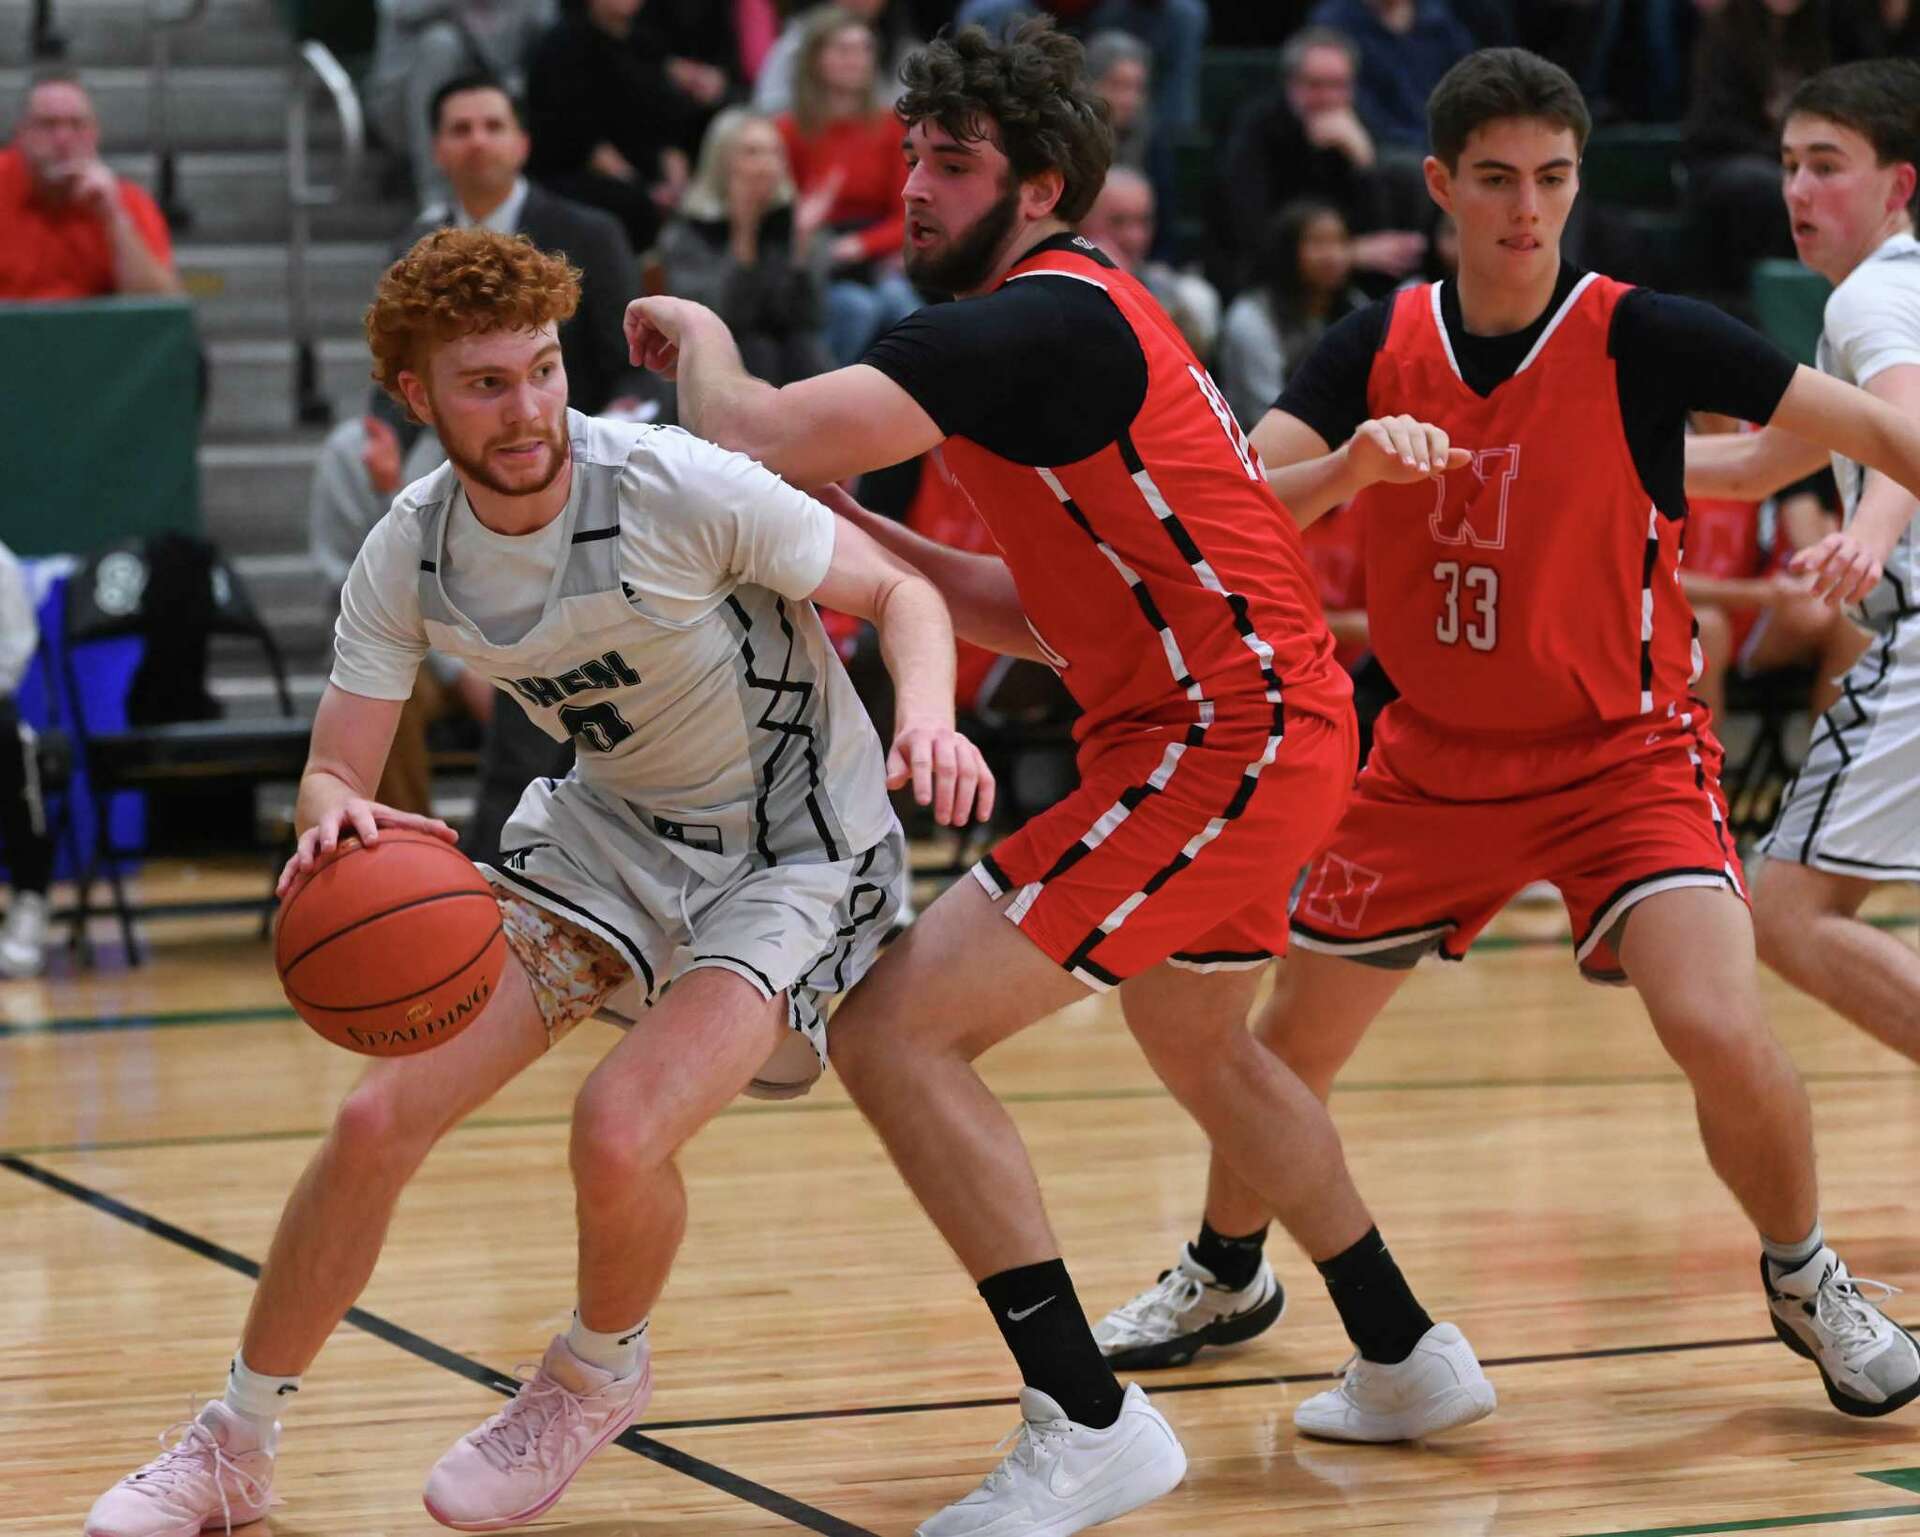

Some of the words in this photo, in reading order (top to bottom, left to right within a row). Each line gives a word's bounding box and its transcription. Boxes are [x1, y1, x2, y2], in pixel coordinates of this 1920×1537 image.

[1432, 560, 1499, 652] 33
[506, 650, 642, 708] HEN
[1305, 851, 1383, 931] N
[346, 975, 490, 1047] SPALDING
